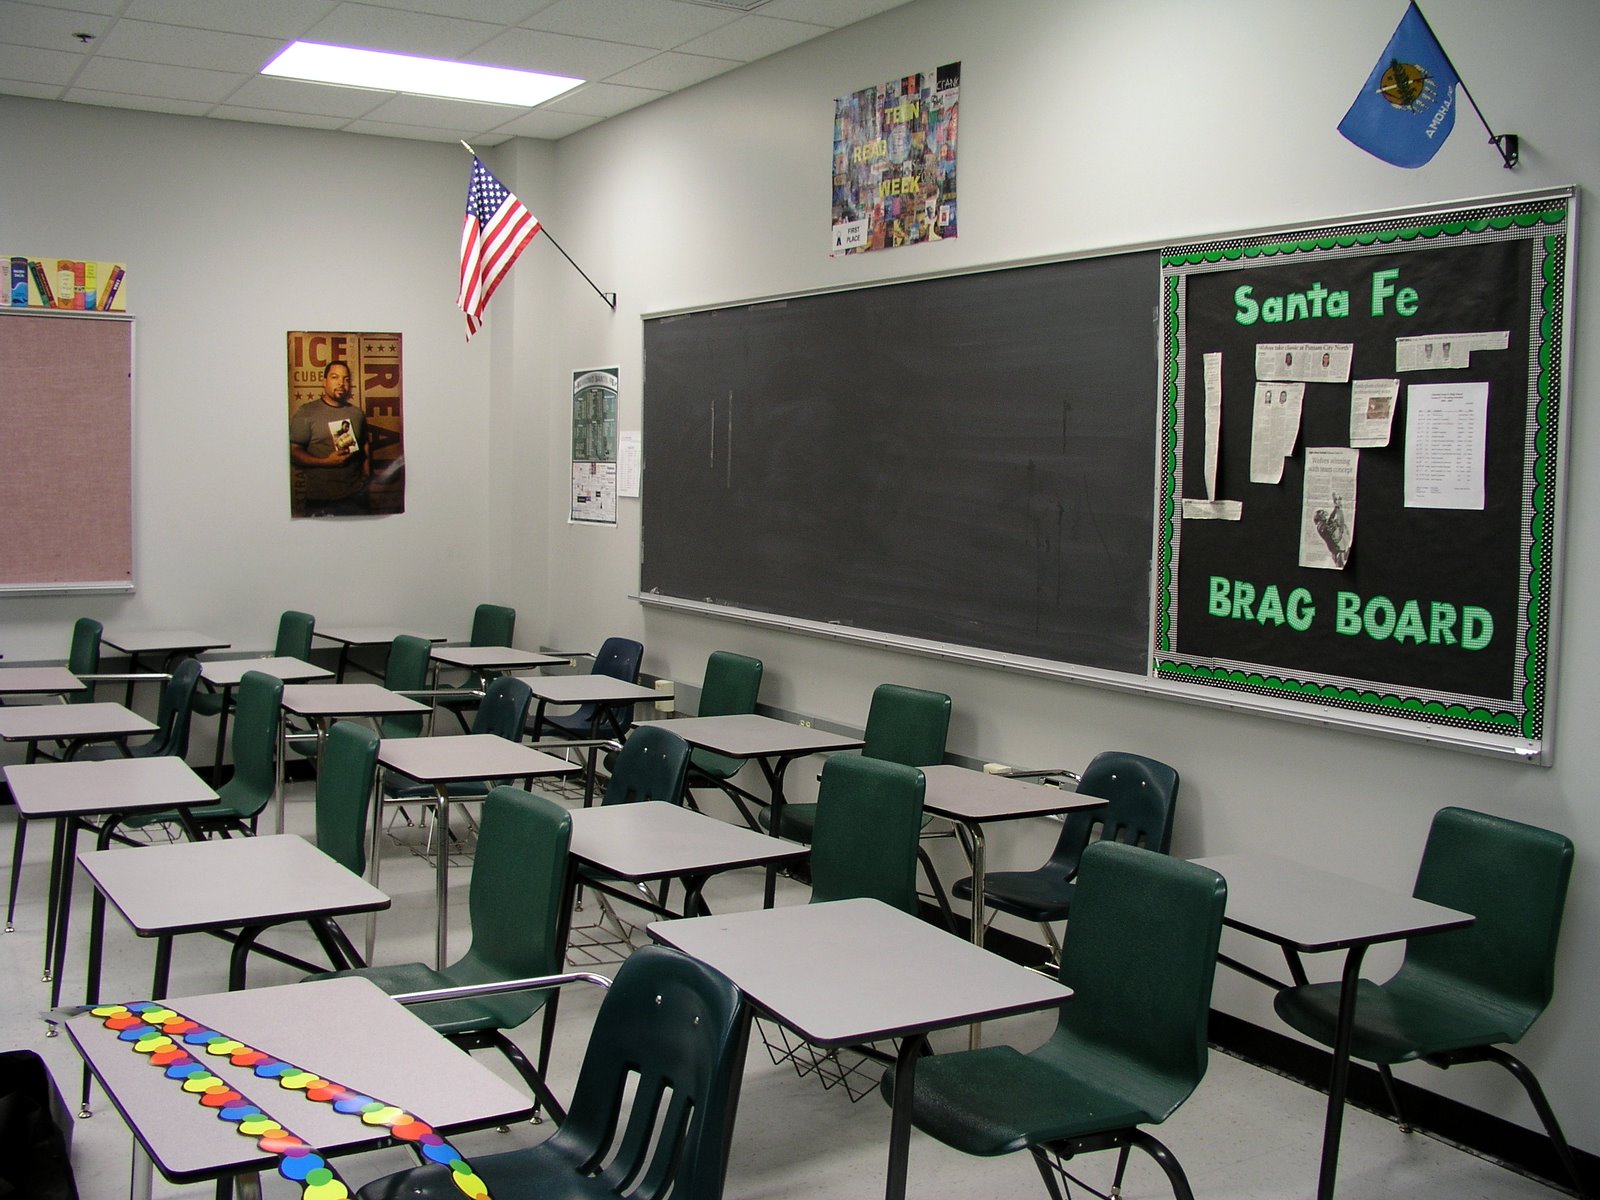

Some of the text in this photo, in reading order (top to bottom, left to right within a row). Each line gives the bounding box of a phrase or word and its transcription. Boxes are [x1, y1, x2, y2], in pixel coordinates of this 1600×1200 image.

[853, 140, 888, 163] READ
[879, 176, 920, 198] WEEK
[846, 234, 860, 243] PLACE
[847, 226, 860, 235] FIRST
[1234, 267, 1420, 327] Santa Fe
[294, 336, 348, 368] ICE
[294, 370, 324, 383] CUBE
[1208, 575, 1495, 651] BRAG BOARD
